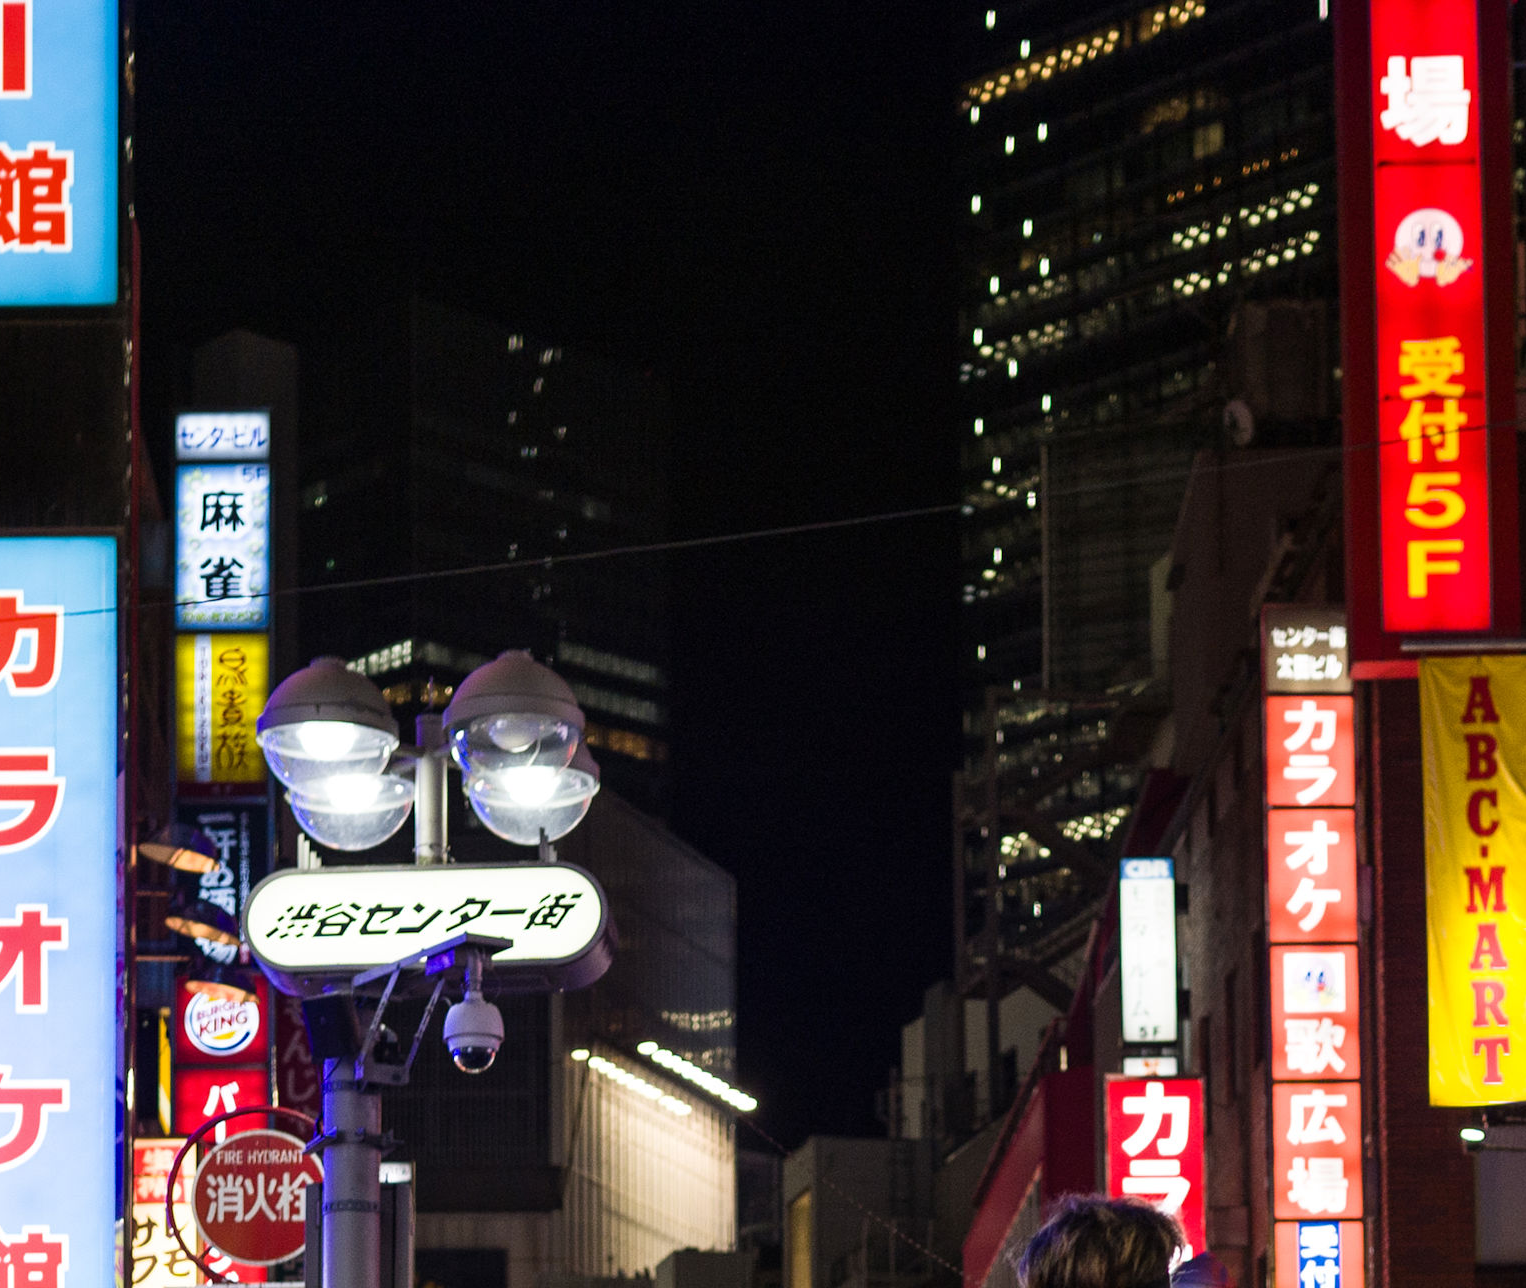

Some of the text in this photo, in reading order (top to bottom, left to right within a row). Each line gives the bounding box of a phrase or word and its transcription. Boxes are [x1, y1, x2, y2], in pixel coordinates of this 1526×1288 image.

[1380, 55, 1471, 146] 場
[178, 424, 269, 450] センタービル
[1399, 337, 1466, 598] 受付5F
[199, 490, 245, 599] 麻雀
[1283, 700, 1342, 931] カラオケ
[265, 892, 583, 939] 渋谷センター街
[1461, 675, 1511, 1087] ABC-MART
[199, 1011, 249, 1038] KING
[215, 1149, 304, 1166] FIRE HYDRANT
[1283, 1019, 1349, 1215] 歌広場
[205, 1172, 314, 1224] 消火栓
